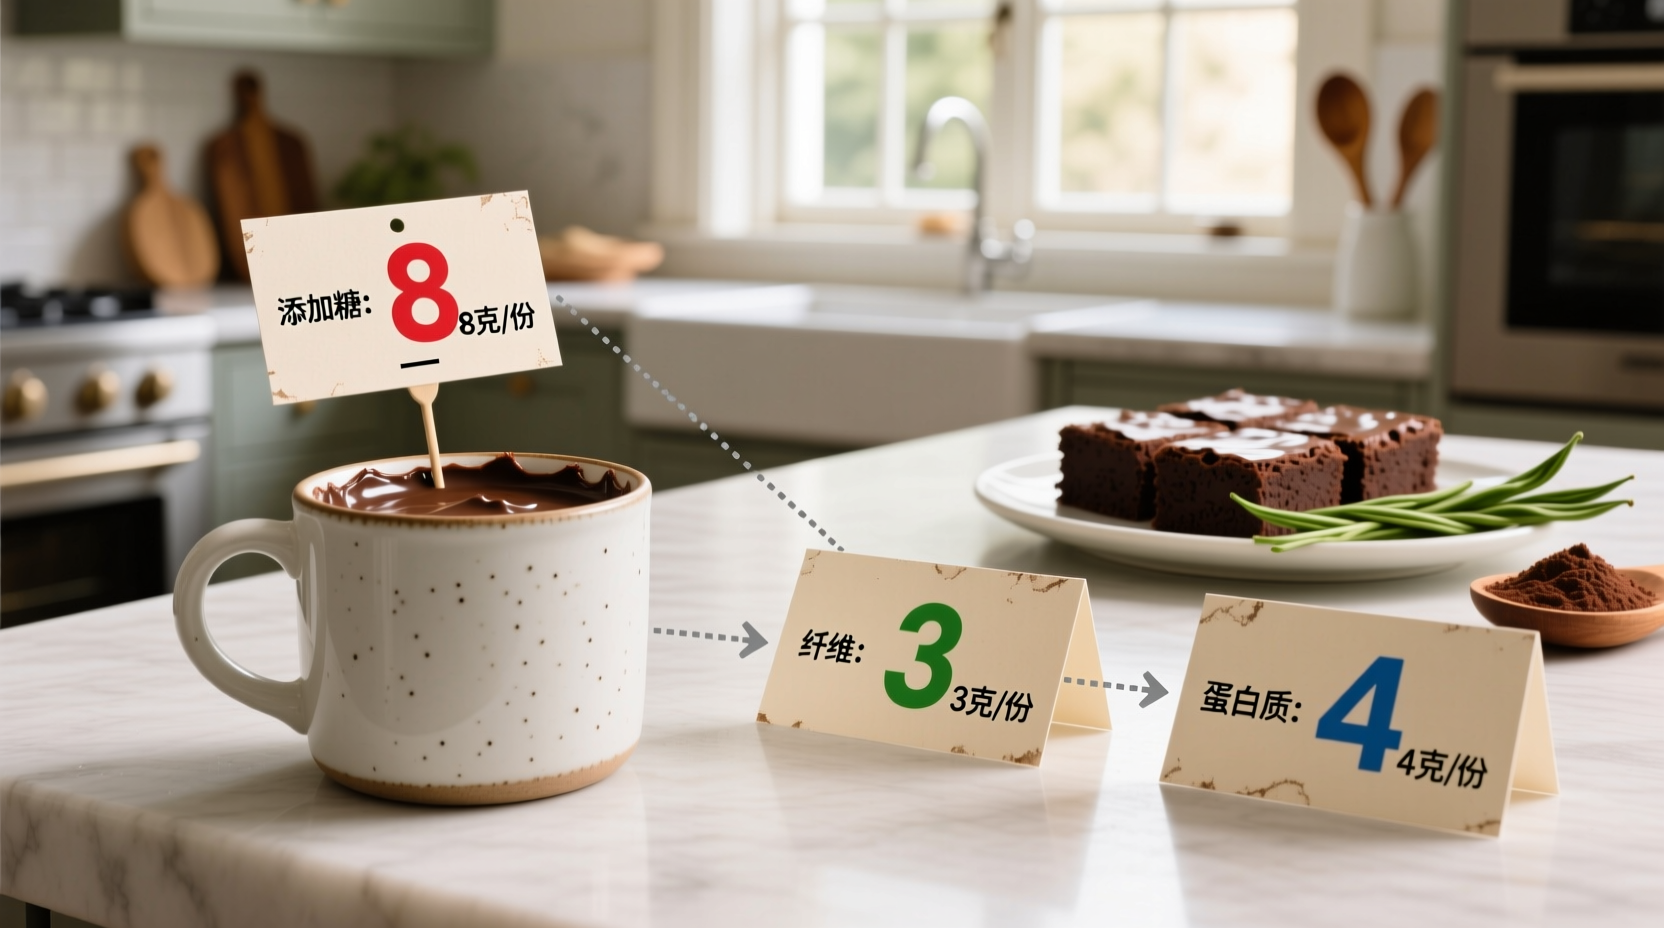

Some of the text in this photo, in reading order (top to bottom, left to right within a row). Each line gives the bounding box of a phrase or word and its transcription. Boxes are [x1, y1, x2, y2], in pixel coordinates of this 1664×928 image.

[387, 242, 459, 343] 8
[458, 301, 535, 336] 8克/份
[884, 602, 963, 709] 3
[949, 685, 1034, 723] 3克/份
[1315, 656, 1404, 773] 4
[1396, 748, 1488, 790] 4克/份
